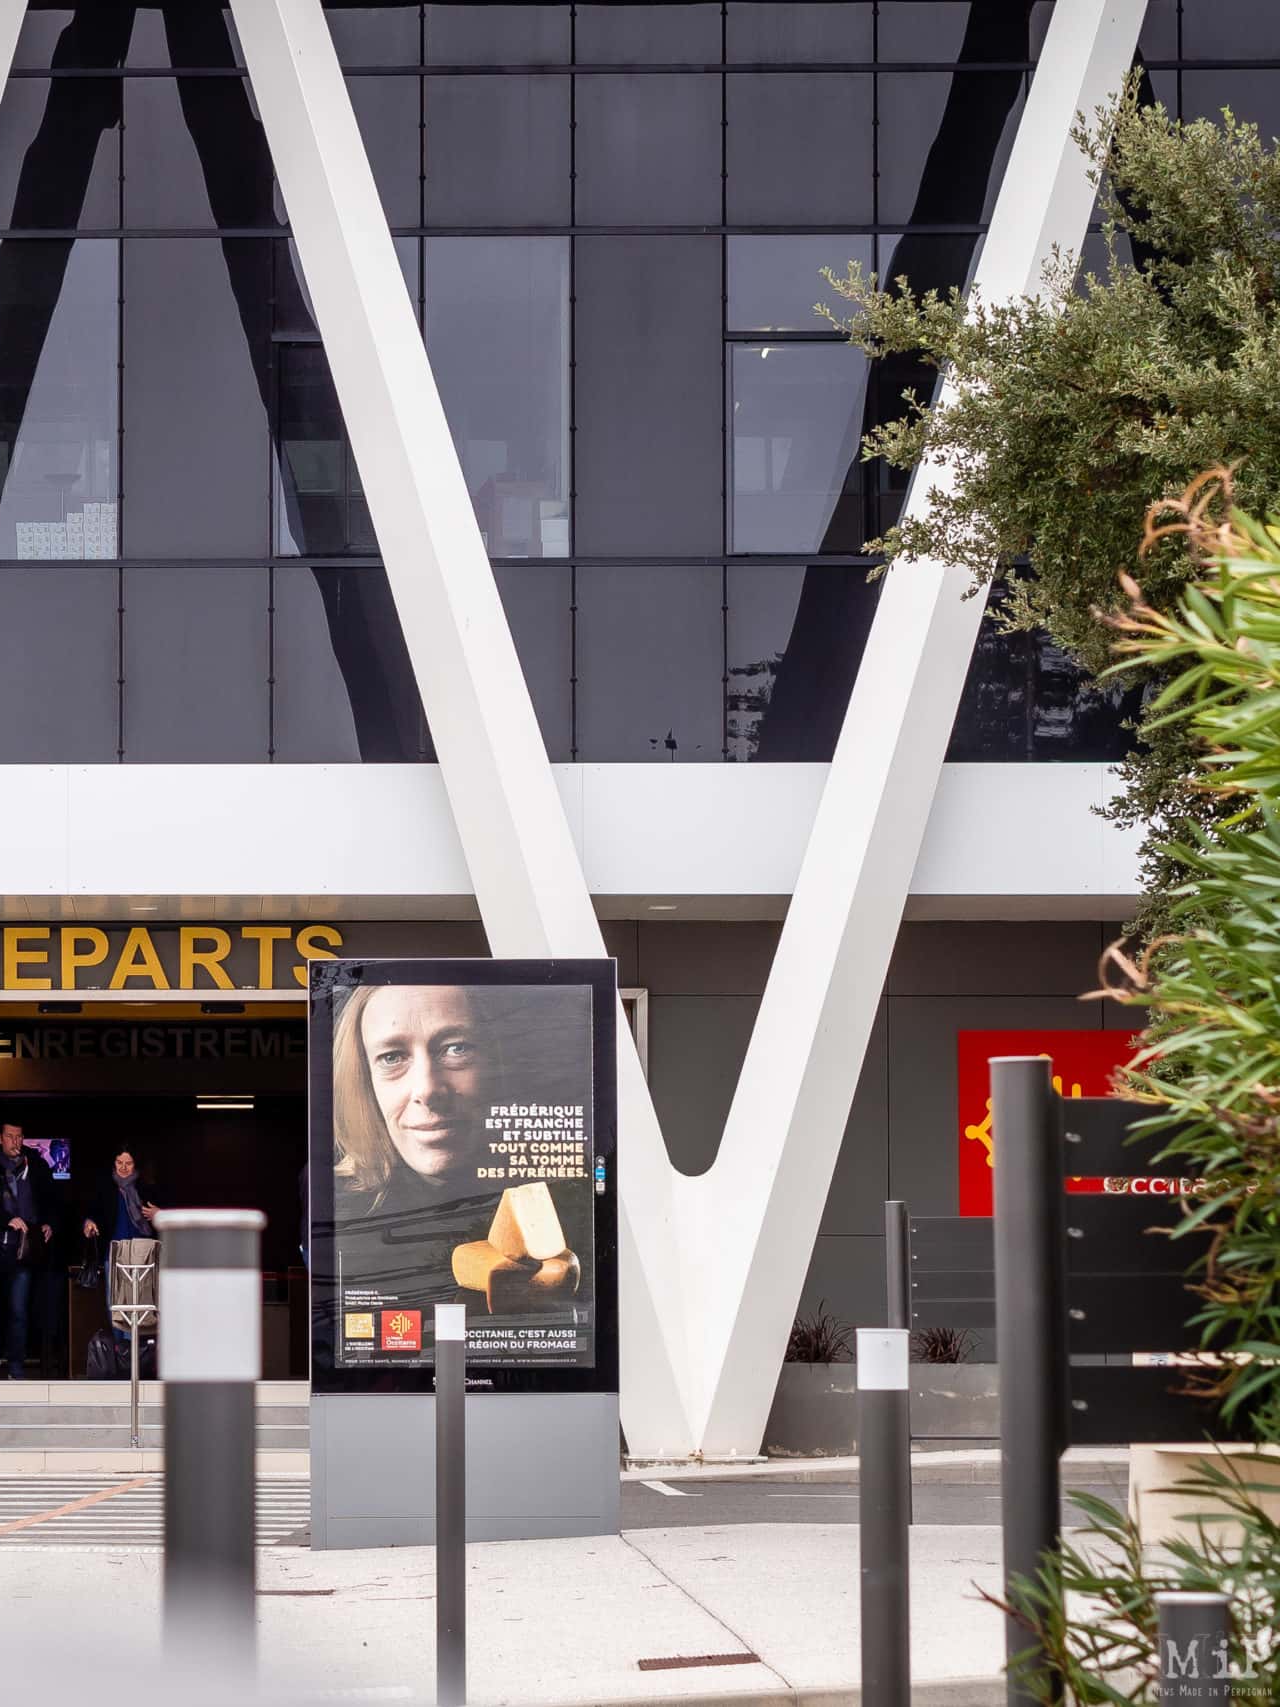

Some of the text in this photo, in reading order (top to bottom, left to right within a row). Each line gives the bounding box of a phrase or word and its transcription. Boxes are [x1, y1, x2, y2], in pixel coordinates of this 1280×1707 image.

[490, 1103, 584, 1118] FRÉDÉRIQUE
[485, 1118, 584, 1129] EST FRANCHE
[503, 1131, 588, 1141] ET SUBTILE.
[489, 1143, 584, 1153] TOUT COMME
[509, 1155, 584, 1165] SA TOMME
[477, 1164, 589, 1178] DES PYRÉNÉES.
[518, 1329, 547, 1338] C'EST
[548, 1330, 577, 1338] AUSSI
[469, 1339, 508, 1349] RÉGION
[510, 1340, 524, 1349] DU
[527, 1340, 577, 1349] FROMAGE
